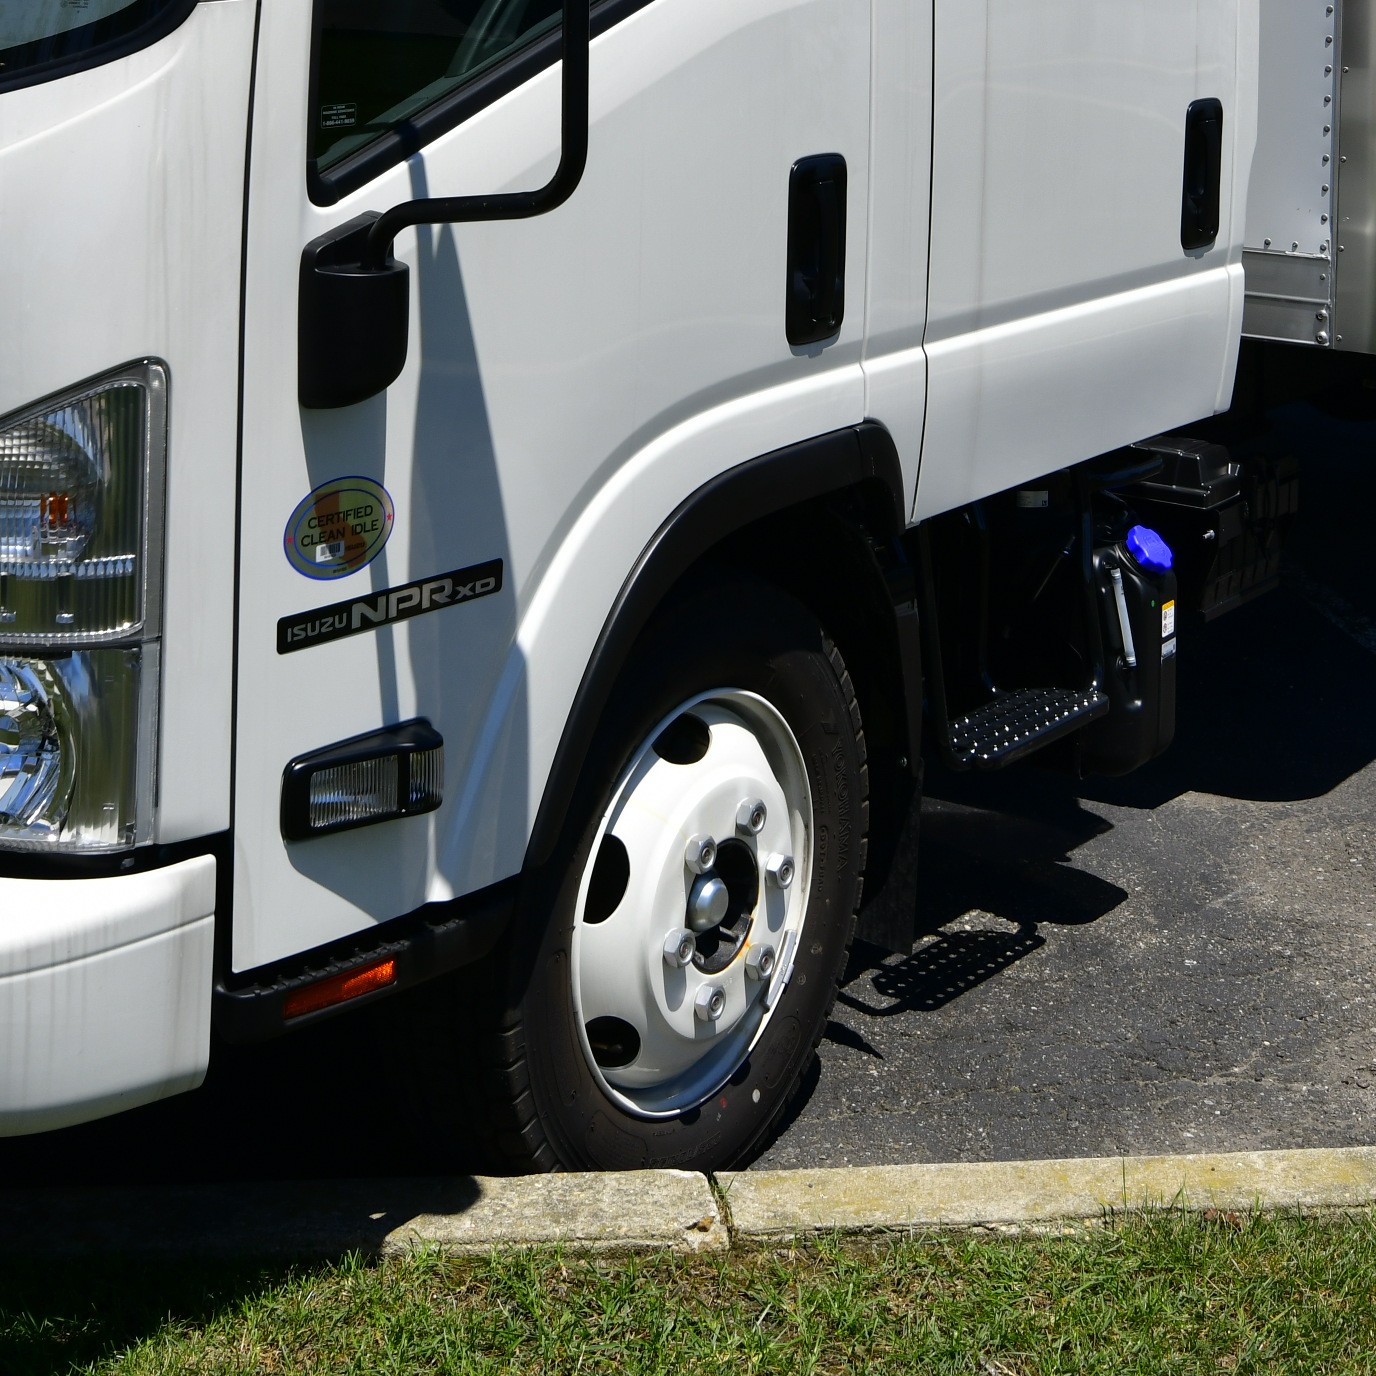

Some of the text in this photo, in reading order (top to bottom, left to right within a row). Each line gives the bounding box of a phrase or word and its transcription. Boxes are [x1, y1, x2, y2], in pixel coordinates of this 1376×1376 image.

[308, 504, 373, 529] CERTIFIED
[301, 519, 379, 547] CLEAN IDLE
[287, 612, 347, 642] ISUZU
